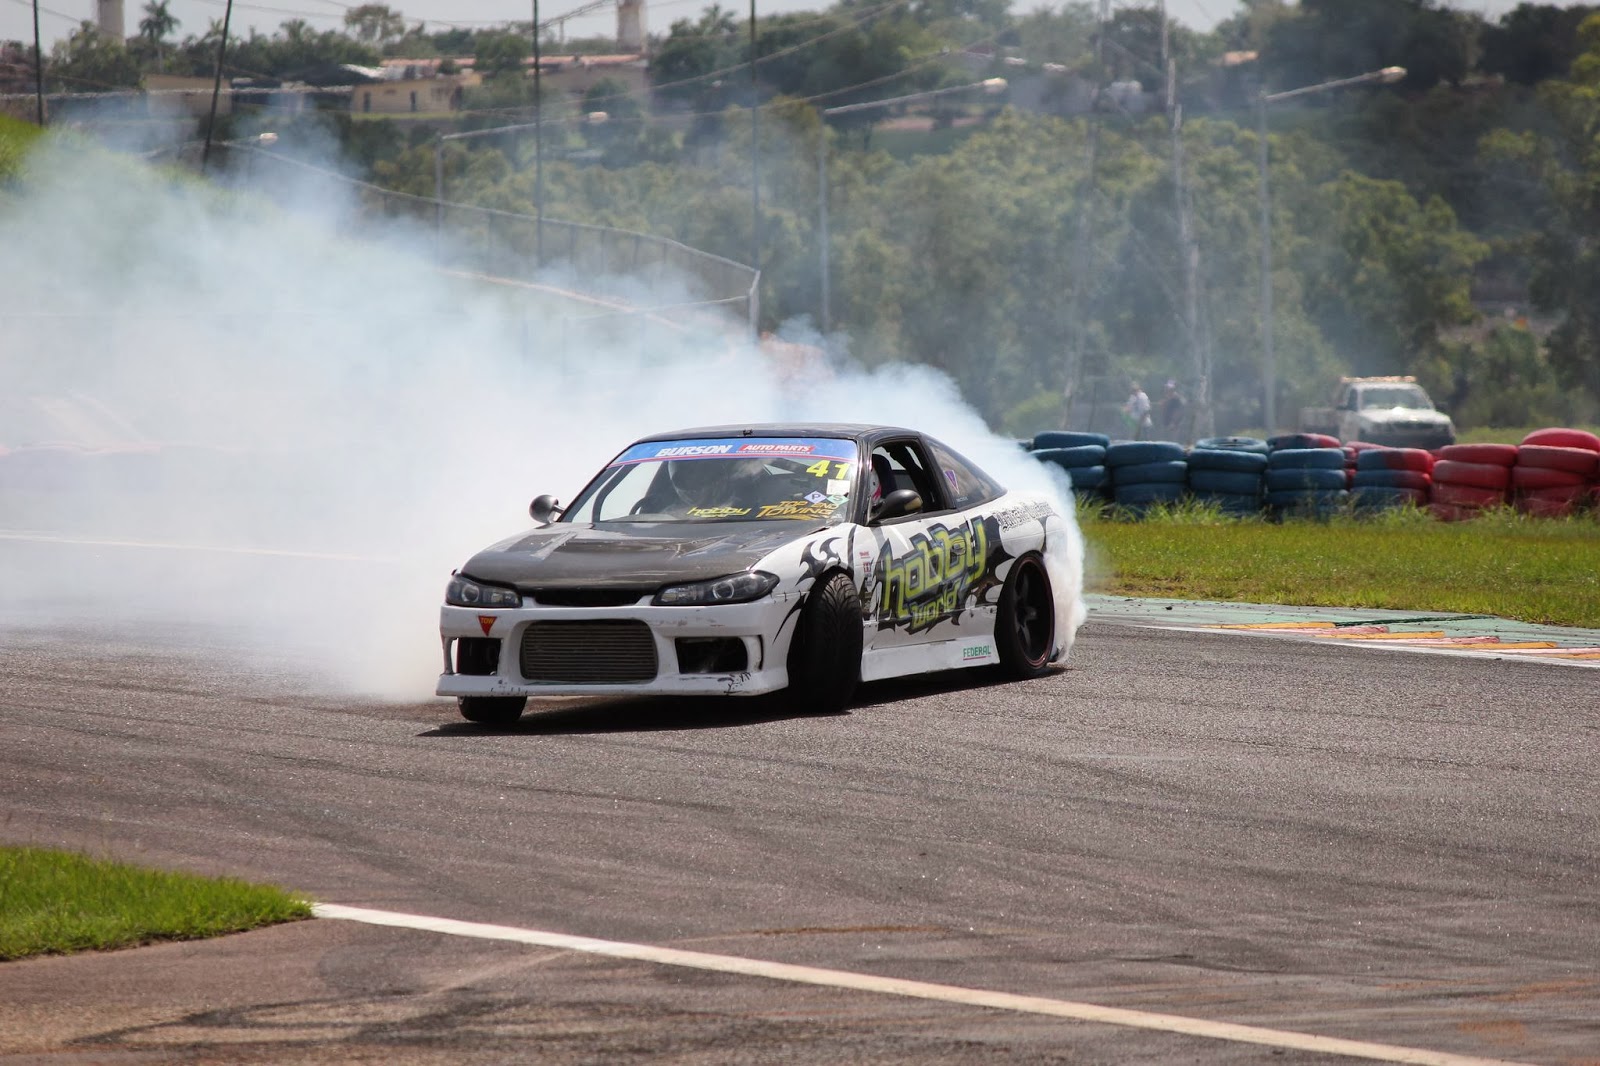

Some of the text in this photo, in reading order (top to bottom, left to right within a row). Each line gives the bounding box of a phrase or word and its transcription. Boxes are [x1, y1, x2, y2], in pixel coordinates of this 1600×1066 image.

[655, 445, 733, 457] BURSON
[806, 460, 850, 480] 41
[811, 502, 839, 510] END
[881, 517, 986, 621] hobby
[963, 645, 991, 657] FEDERAL
